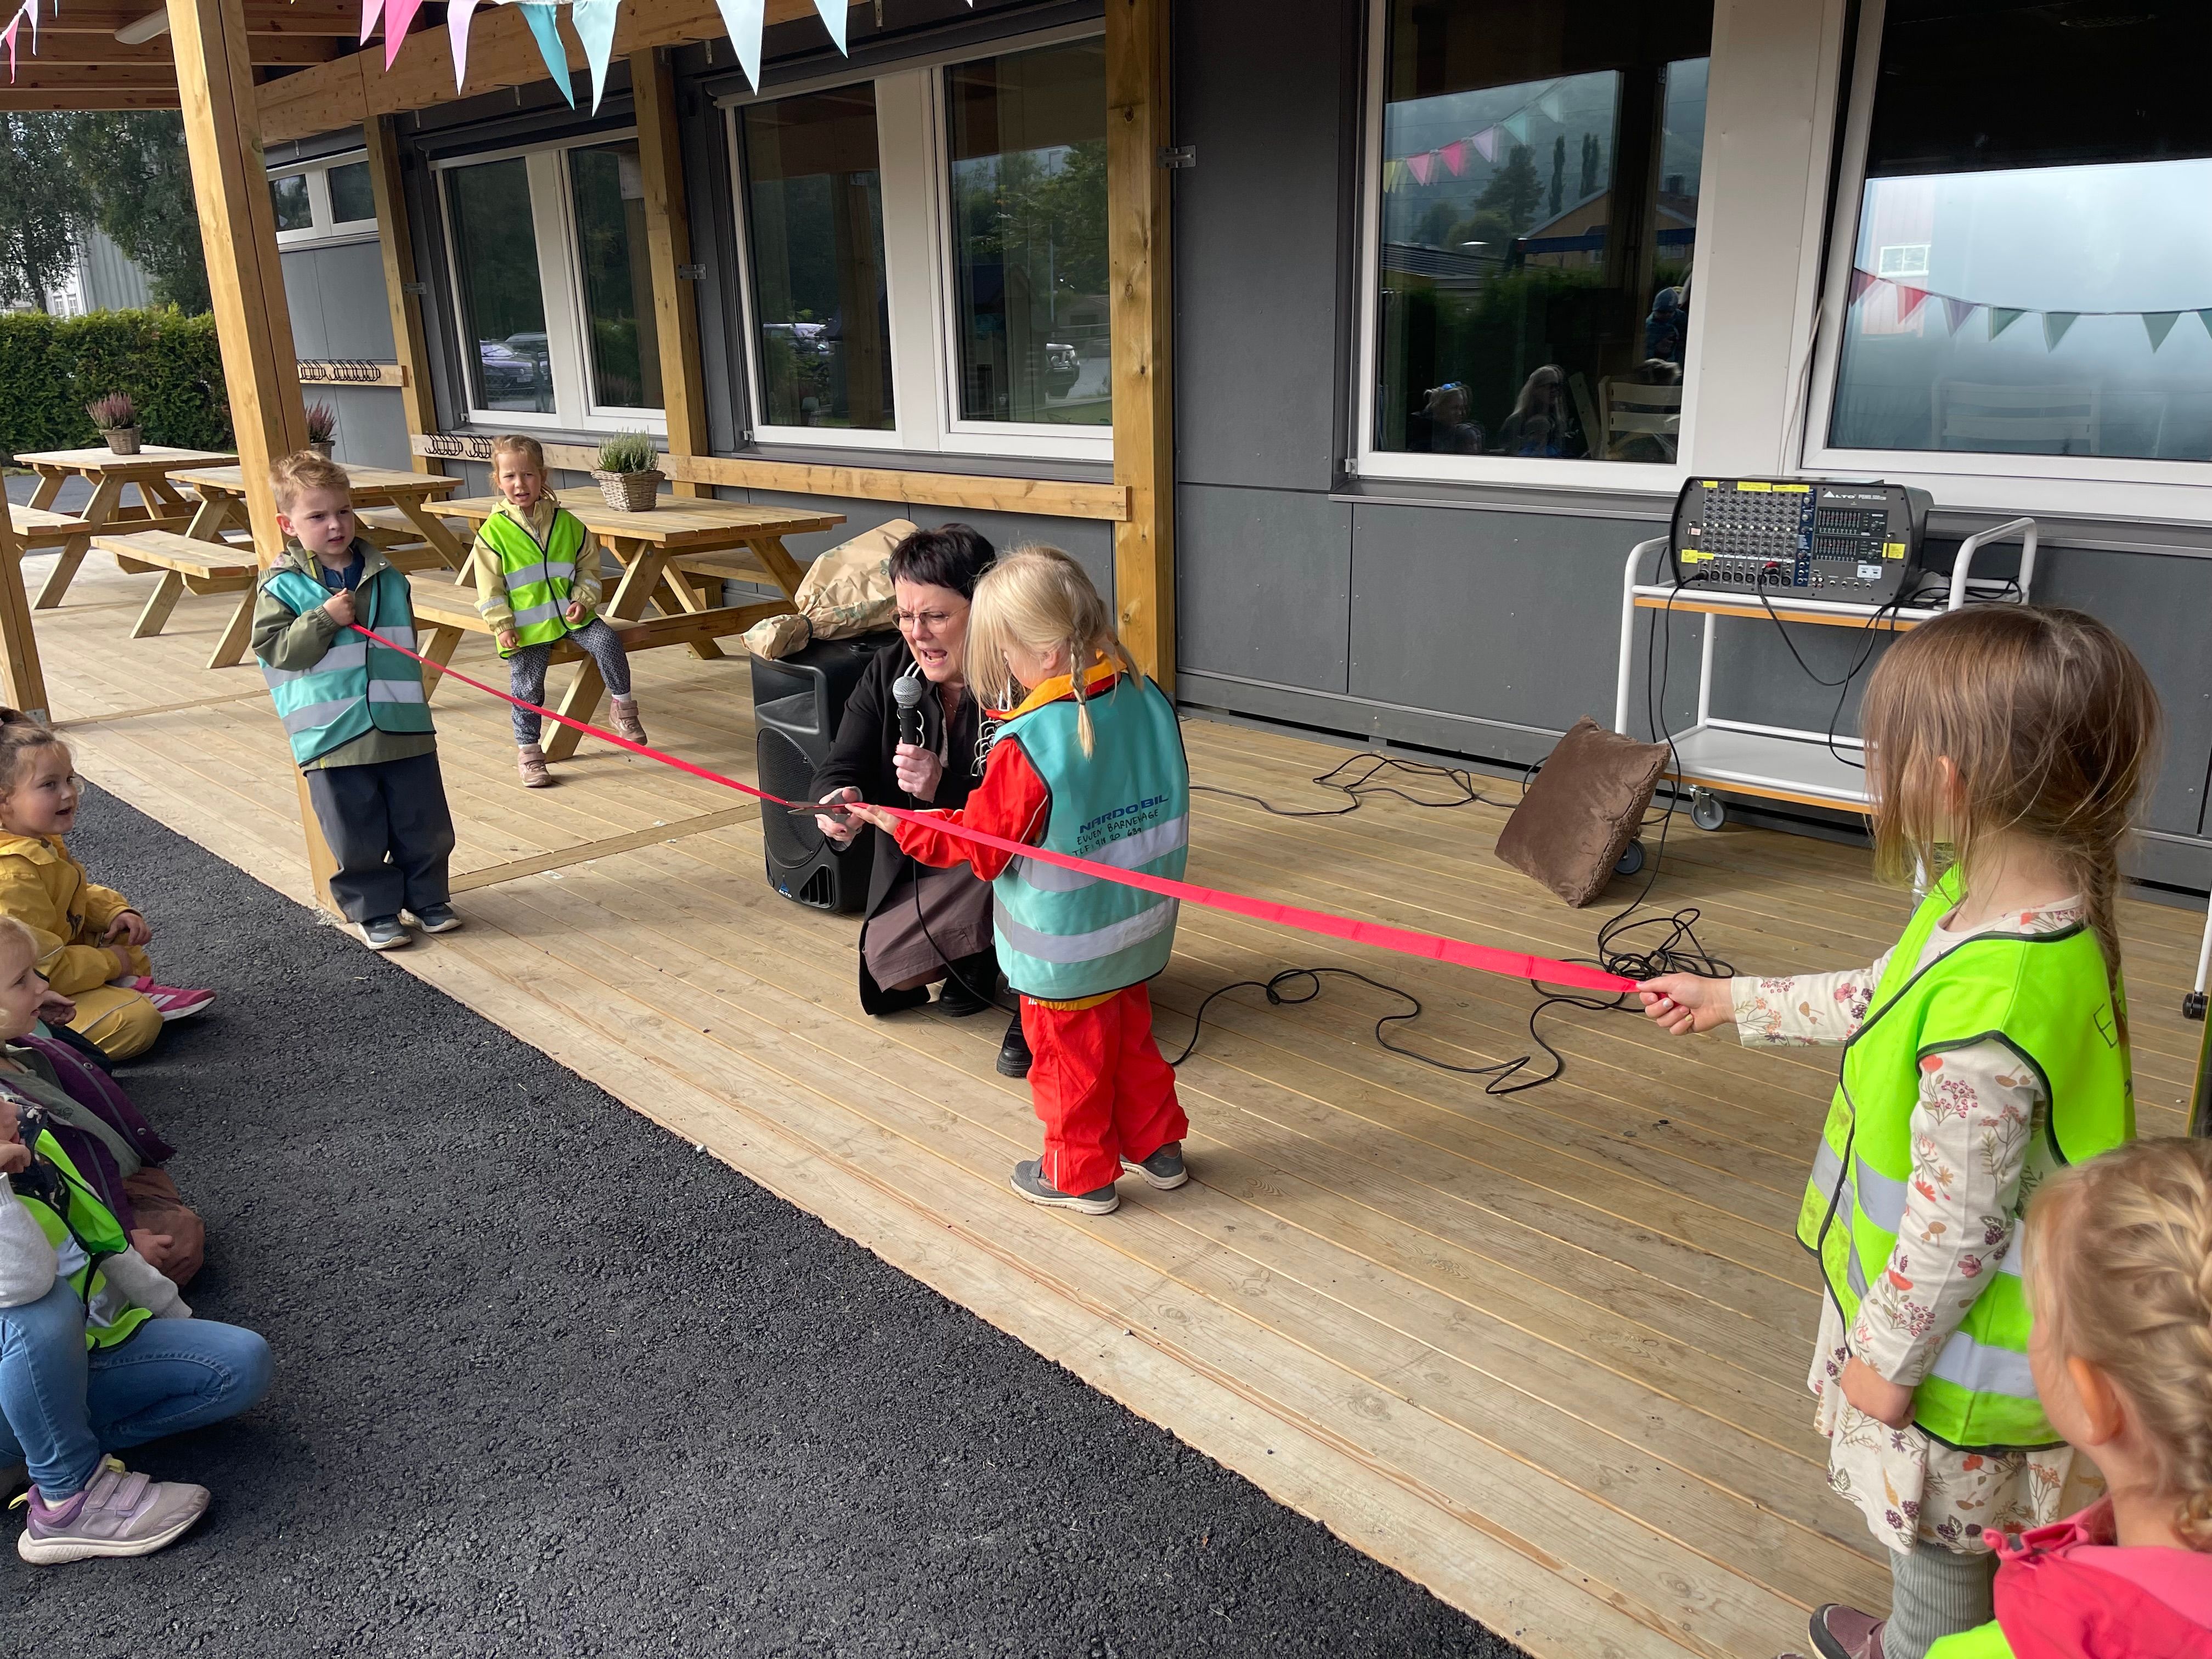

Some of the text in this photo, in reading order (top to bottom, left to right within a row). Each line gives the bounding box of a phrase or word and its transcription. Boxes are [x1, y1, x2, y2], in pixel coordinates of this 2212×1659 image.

[1080, 795, 1169, 834] NARDO BIL
[1110, 833, 1120, 841] 20
[778, 889, 792, 898] ALTO
